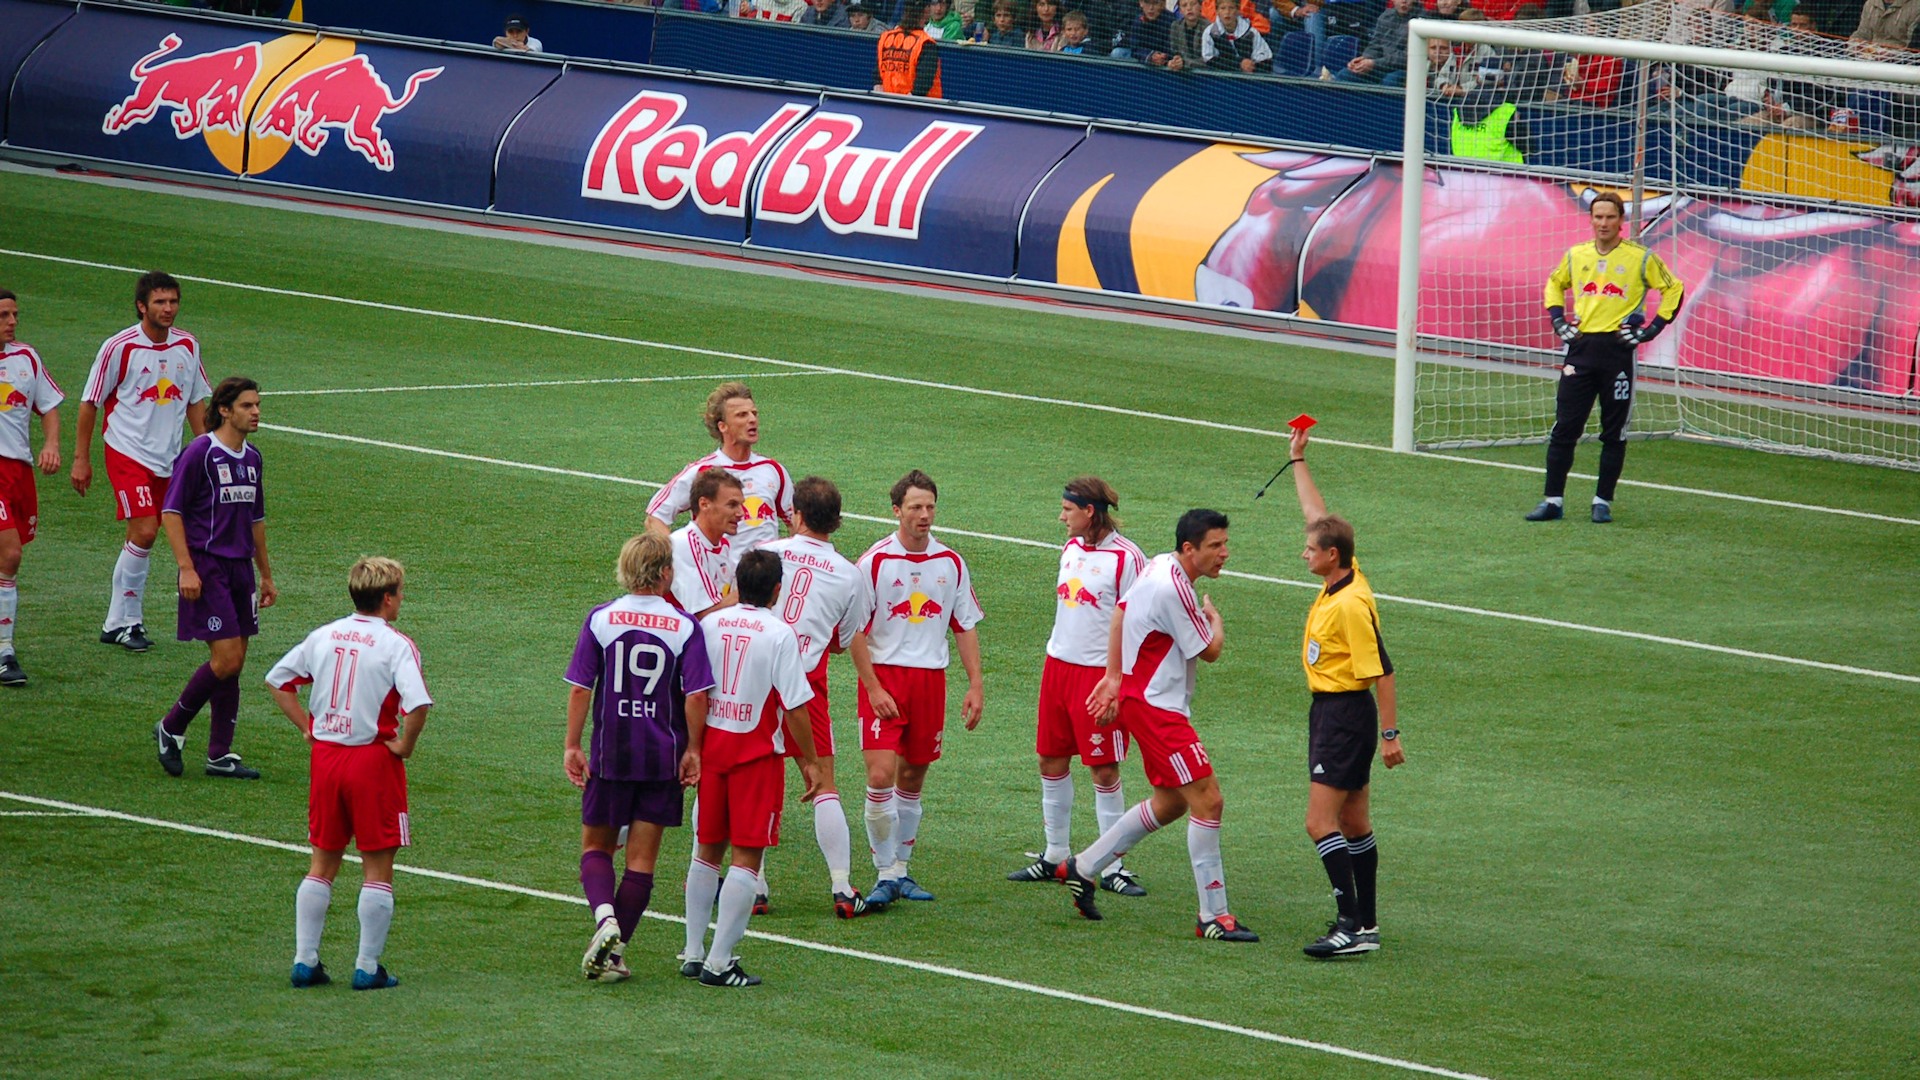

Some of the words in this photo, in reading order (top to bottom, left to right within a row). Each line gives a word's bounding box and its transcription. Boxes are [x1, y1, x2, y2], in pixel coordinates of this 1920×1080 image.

[582, 90, 810, 217] Red
[755, 112, 985, 238] Bull
[1614, 380, 1630, 400] 22
[136, 486, 153, 507] 33
[783, 567, 813, 625] 8
[611, 612, 677, 631] KURIER
[330, 647, 359, 711] 11
[613, 640, 667, 696] 19
[721, 633, 752, 696] 17
[618, 699, 657, 719] CEH
[870, 717, 882, 740] 4
